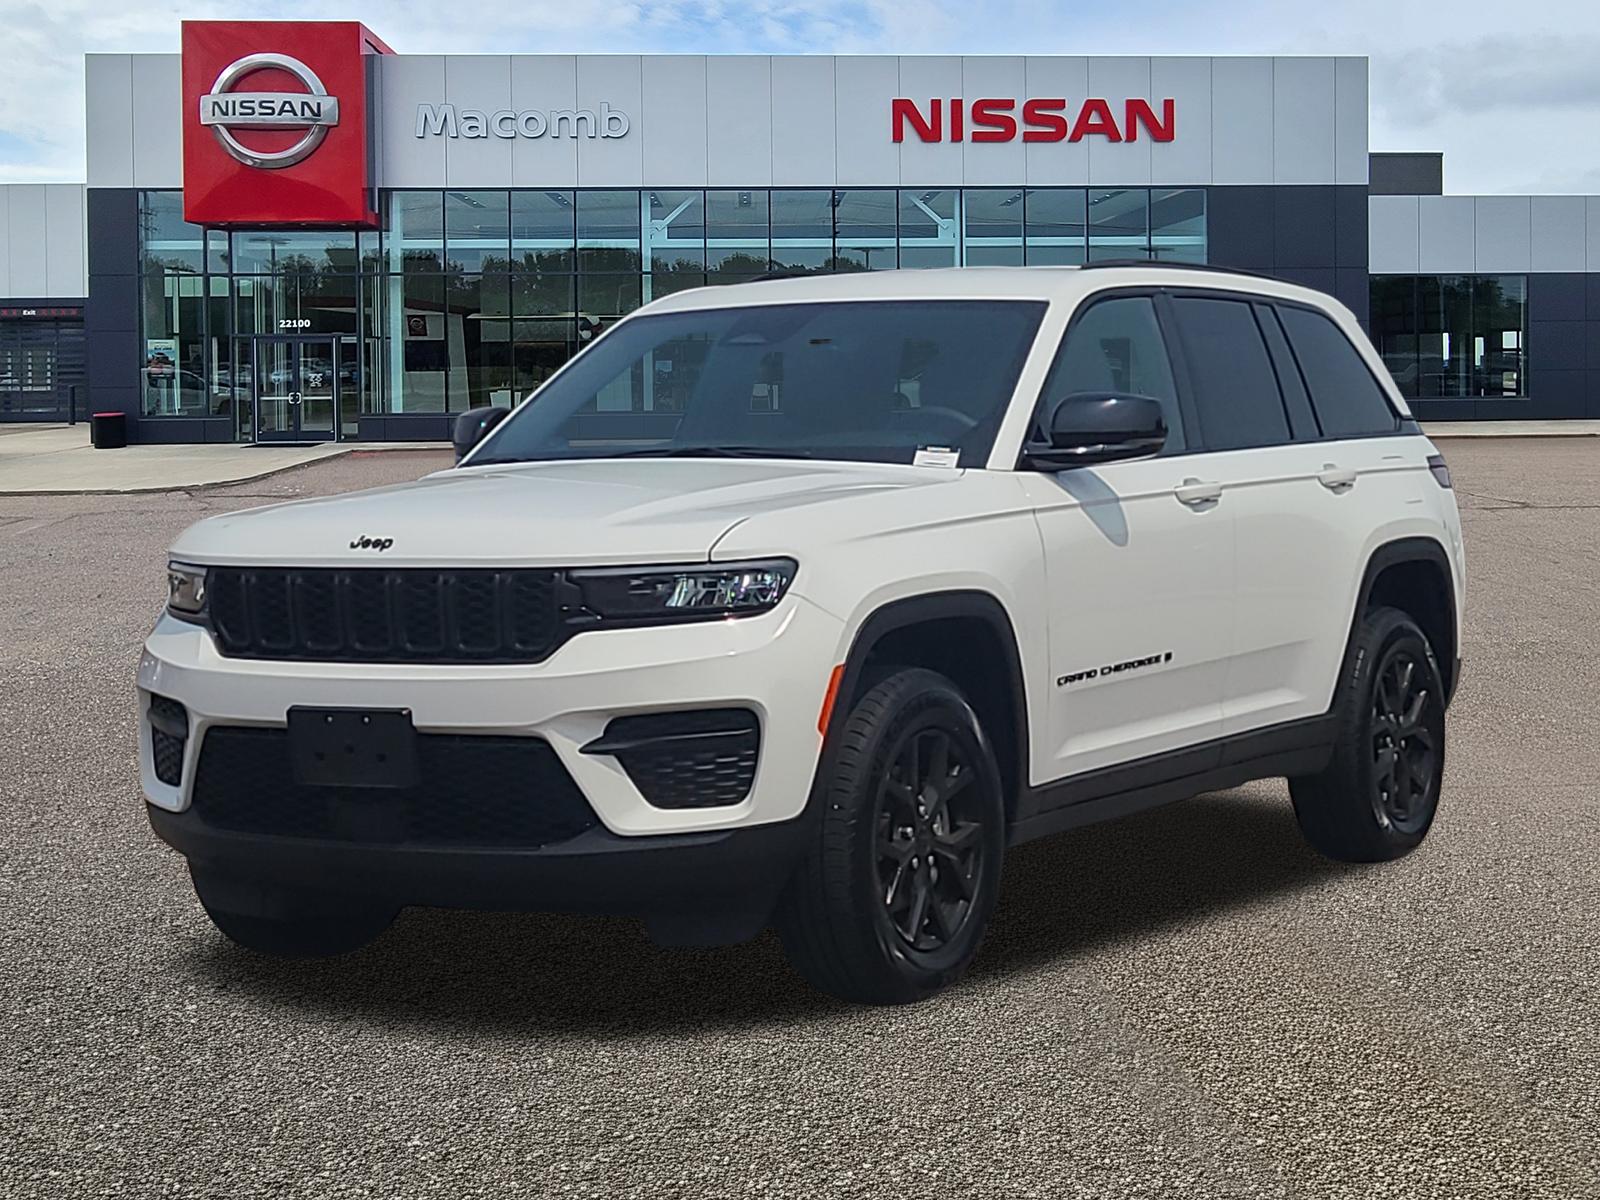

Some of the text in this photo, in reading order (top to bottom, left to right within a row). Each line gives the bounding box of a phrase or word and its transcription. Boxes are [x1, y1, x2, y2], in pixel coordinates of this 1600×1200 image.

[211, 100, 322, 118] NISSAN
[415, 102, 630, 139] Macomb
[892, 98, 1175, 143] NISSAN
[279, 319, 311, 328] 22100
[349, 535, 394, 552] Jeep
[1057, 654, 1162, 687] GRAND CHEROKEE
